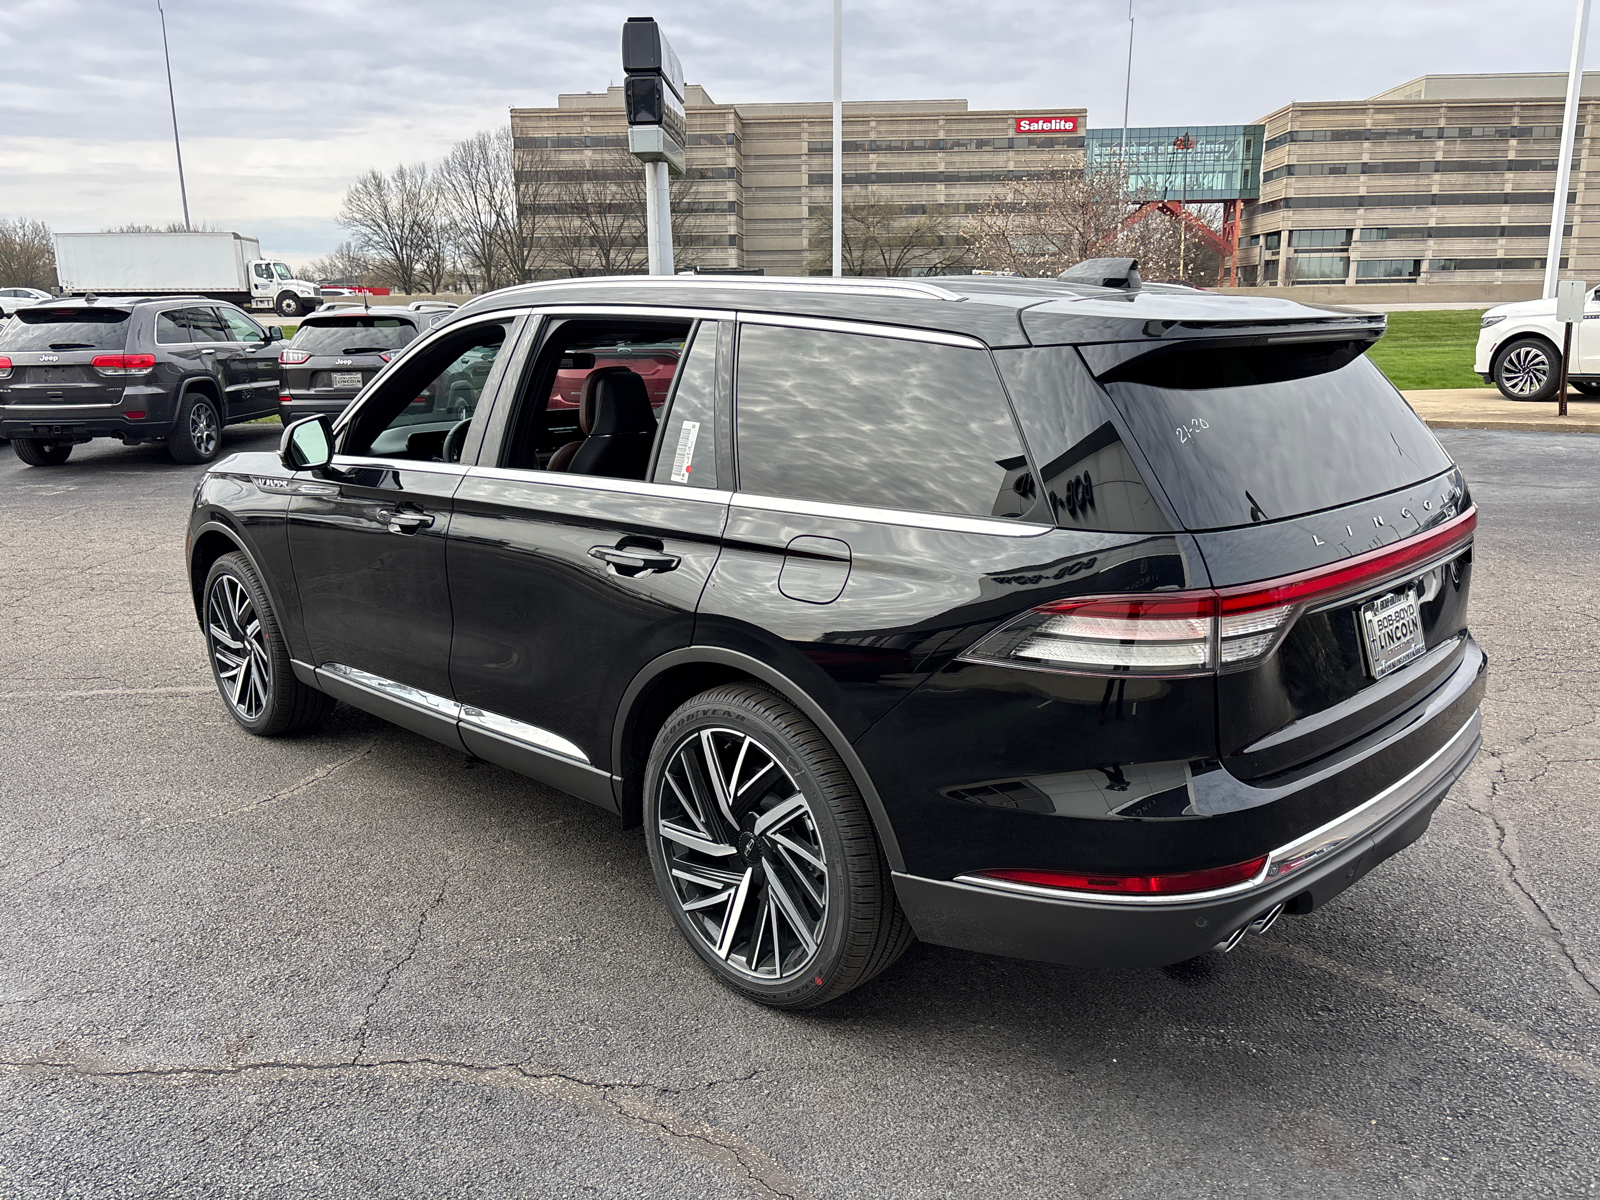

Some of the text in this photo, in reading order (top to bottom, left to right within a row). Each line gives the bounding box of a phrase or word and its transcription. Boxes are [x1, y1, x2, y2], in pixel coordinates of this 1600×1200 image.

[1020, 119, 1073, 130] Safelite
[39, 354, 59, 363] Jeep
[1312, 487, 1461, 546] LINCOLN
[1376, 604, 1415, 631] BOB-BOYD
[1378, 616, 1418, 649] LINCOLN
[662, 708, 746, 744] GOODYEAR
